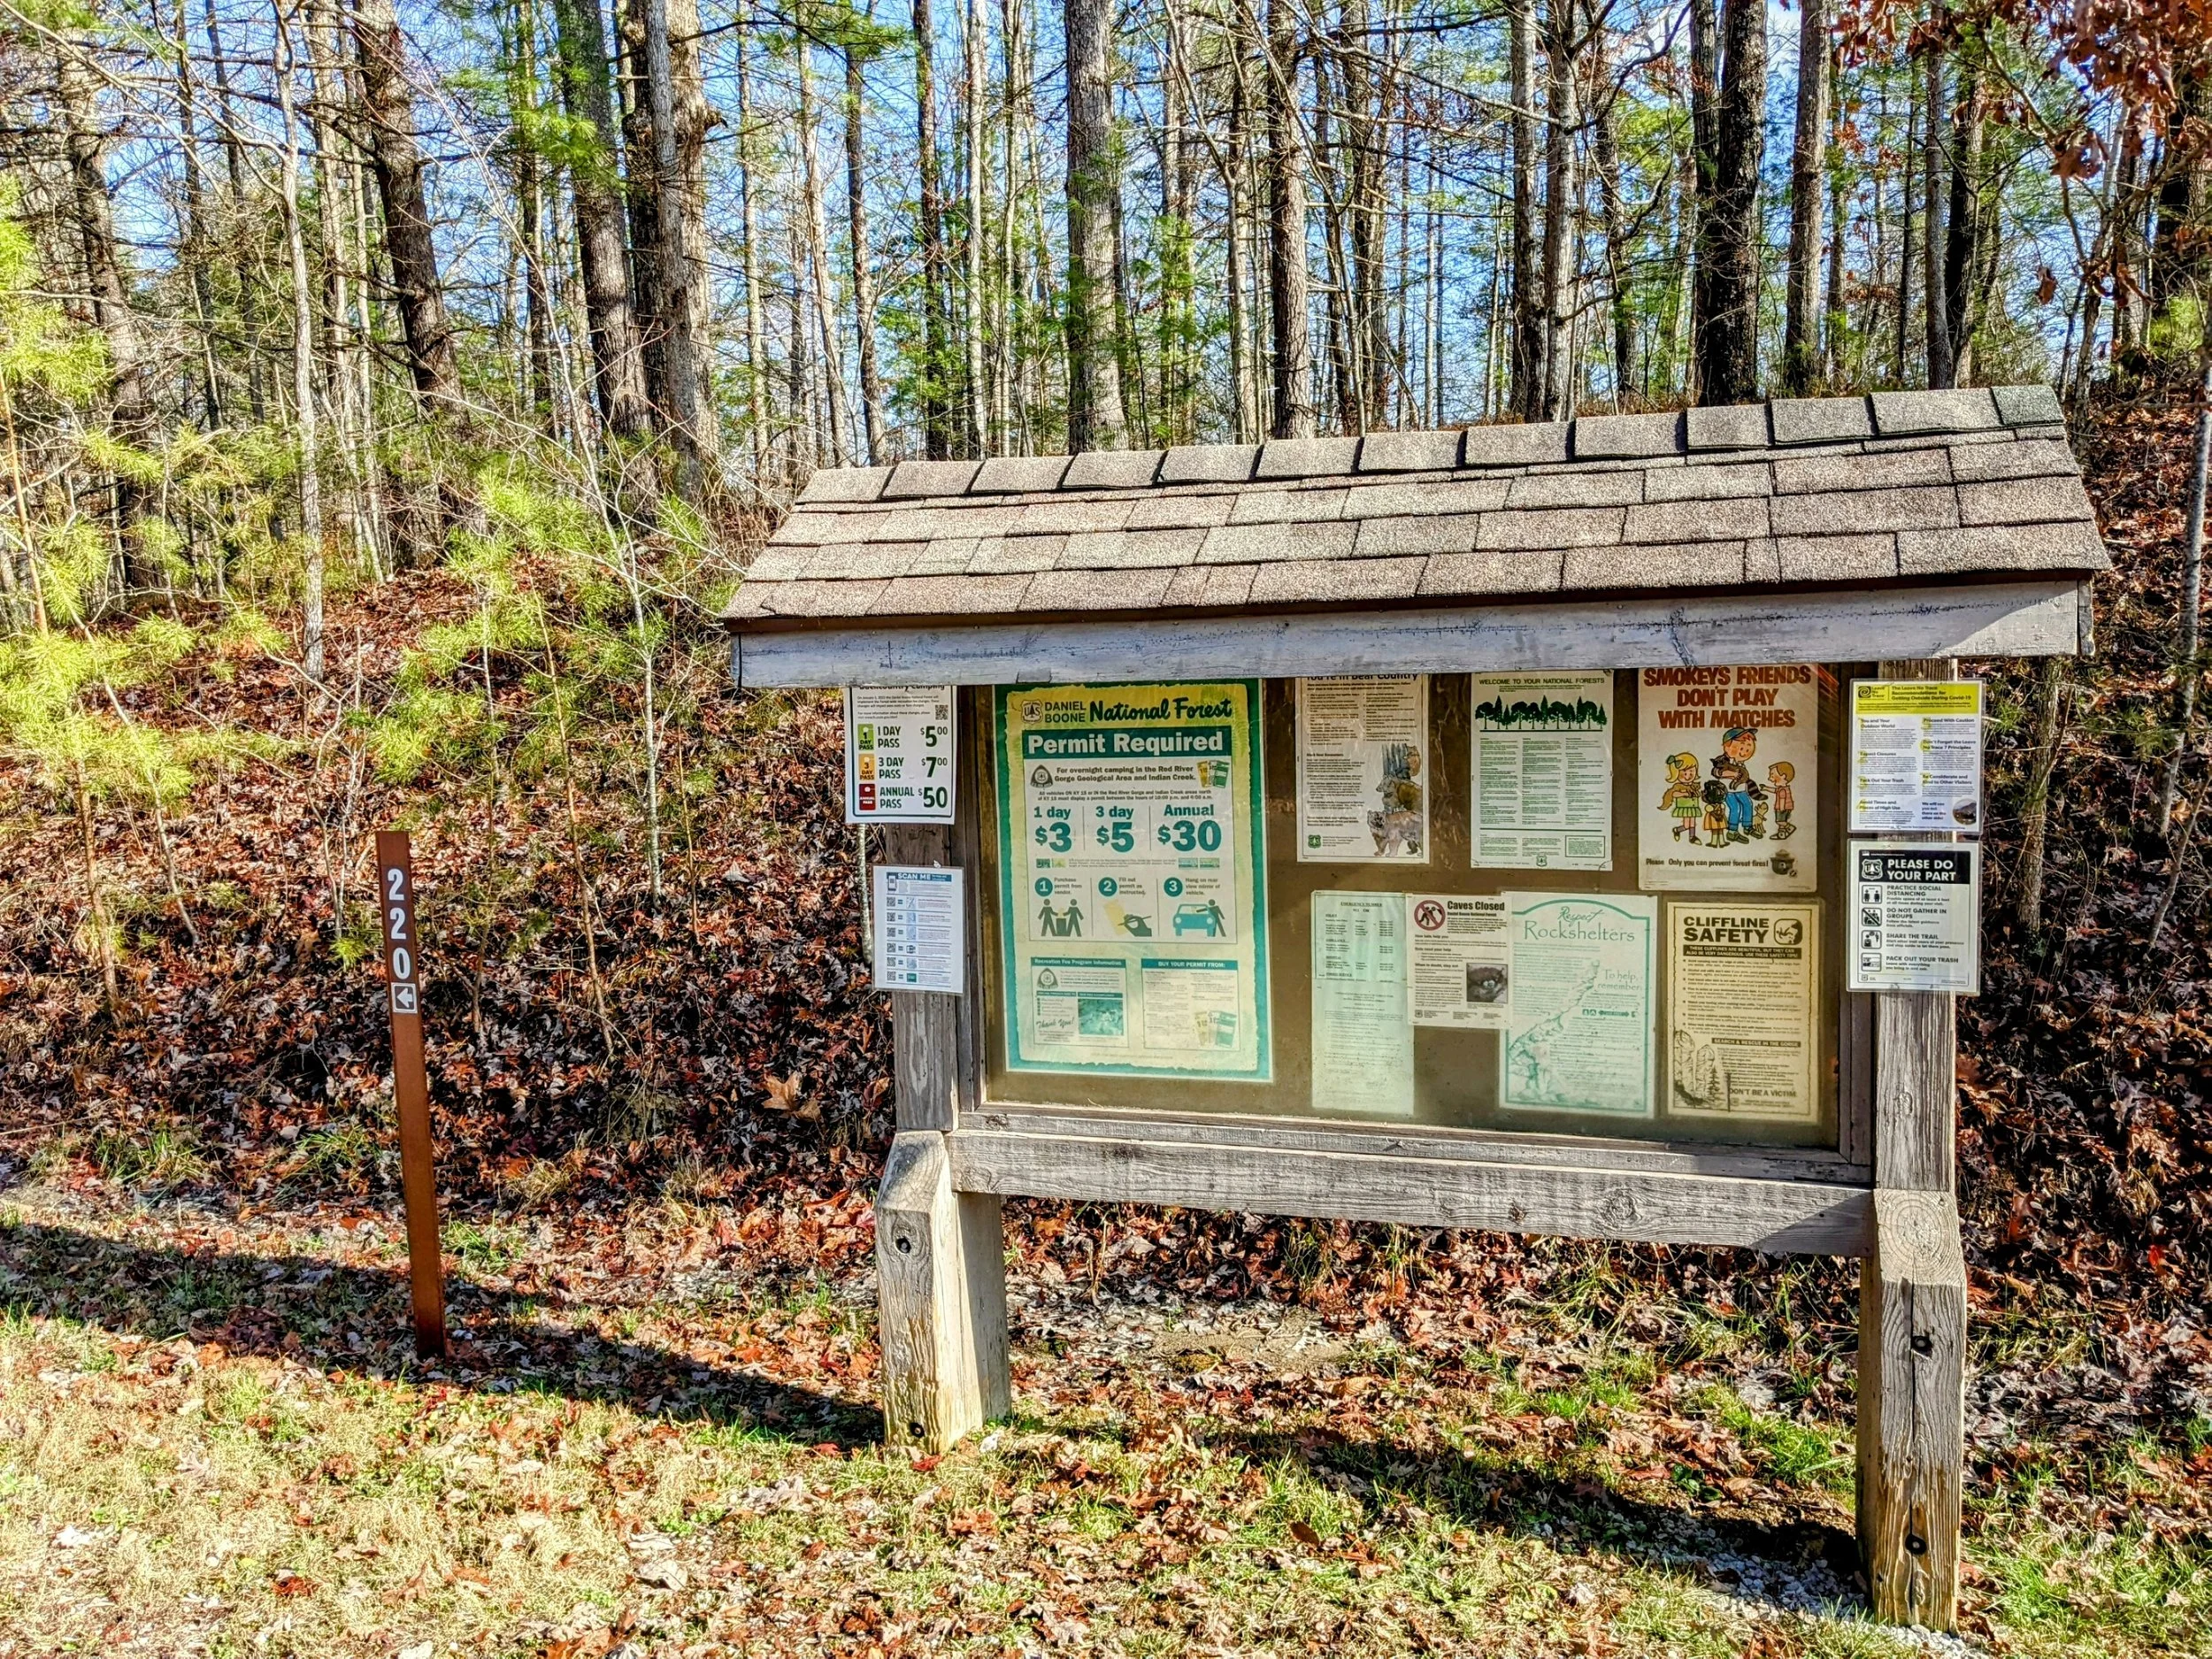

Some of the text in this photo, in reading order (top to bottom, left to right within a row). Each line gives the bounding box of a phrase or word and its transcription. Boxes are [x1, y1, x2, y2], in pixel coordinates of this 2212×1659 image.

[1644, 665, 1811, 687] SMOKEY'S FRIENDS
[1678, 686, 1778, 707] DON'T PLAY
[1045, 697, 1232, 722] DANIEL National Forest
[1045, 713, 1086, 723] BOONE
[1658, 710, 1795, 728] WITH MATCHES
[878, 726, 880, 735] 1
[883, 726, 901, 736] DAY
[878, 739, 900, 748] PASS
[1028, 732, 1223, 756] Permit Required
[879, 757, 884, 766] 3
[887, 757, 904, 766] DAY
[879, 770, 901, 779] PASS
[880, 787, 948, 808] ANNUAL $50
[880, 799, 902, 809] PASS
[1034, 806, 1071, 820] 1 day
[1096, 806, 1133, 820] 3 day
[1164, 803, 1214, 817] Annual
[1035, 822, 1072, 853] $3
[1096, 822, 1134, 853] $5
[1157, 820, 1222, 852] $30
[1669, 858, 1683, 867] Only
[1887, 859, 1953, 869] PLEASE DO
[1886, 872, 1956, 881] YOUR PART
[1040, 881, 1048, 892] 1
[1103, 880, 1112, 892] 2
[1169, 880, 1178, 892] 3
[1448, 901, 1505, 910] Caves Closed
[1558, 906, 1604, 926] Respect
[1684, 917, 1770, 928] CLIFFLINE
[388, 869, 411, 979] 220
[1525, 920, 1635, 942] Rockshelters
[1684, 928, 1770, 943] SAFETY
[1605, 970, 1616, 979] To
